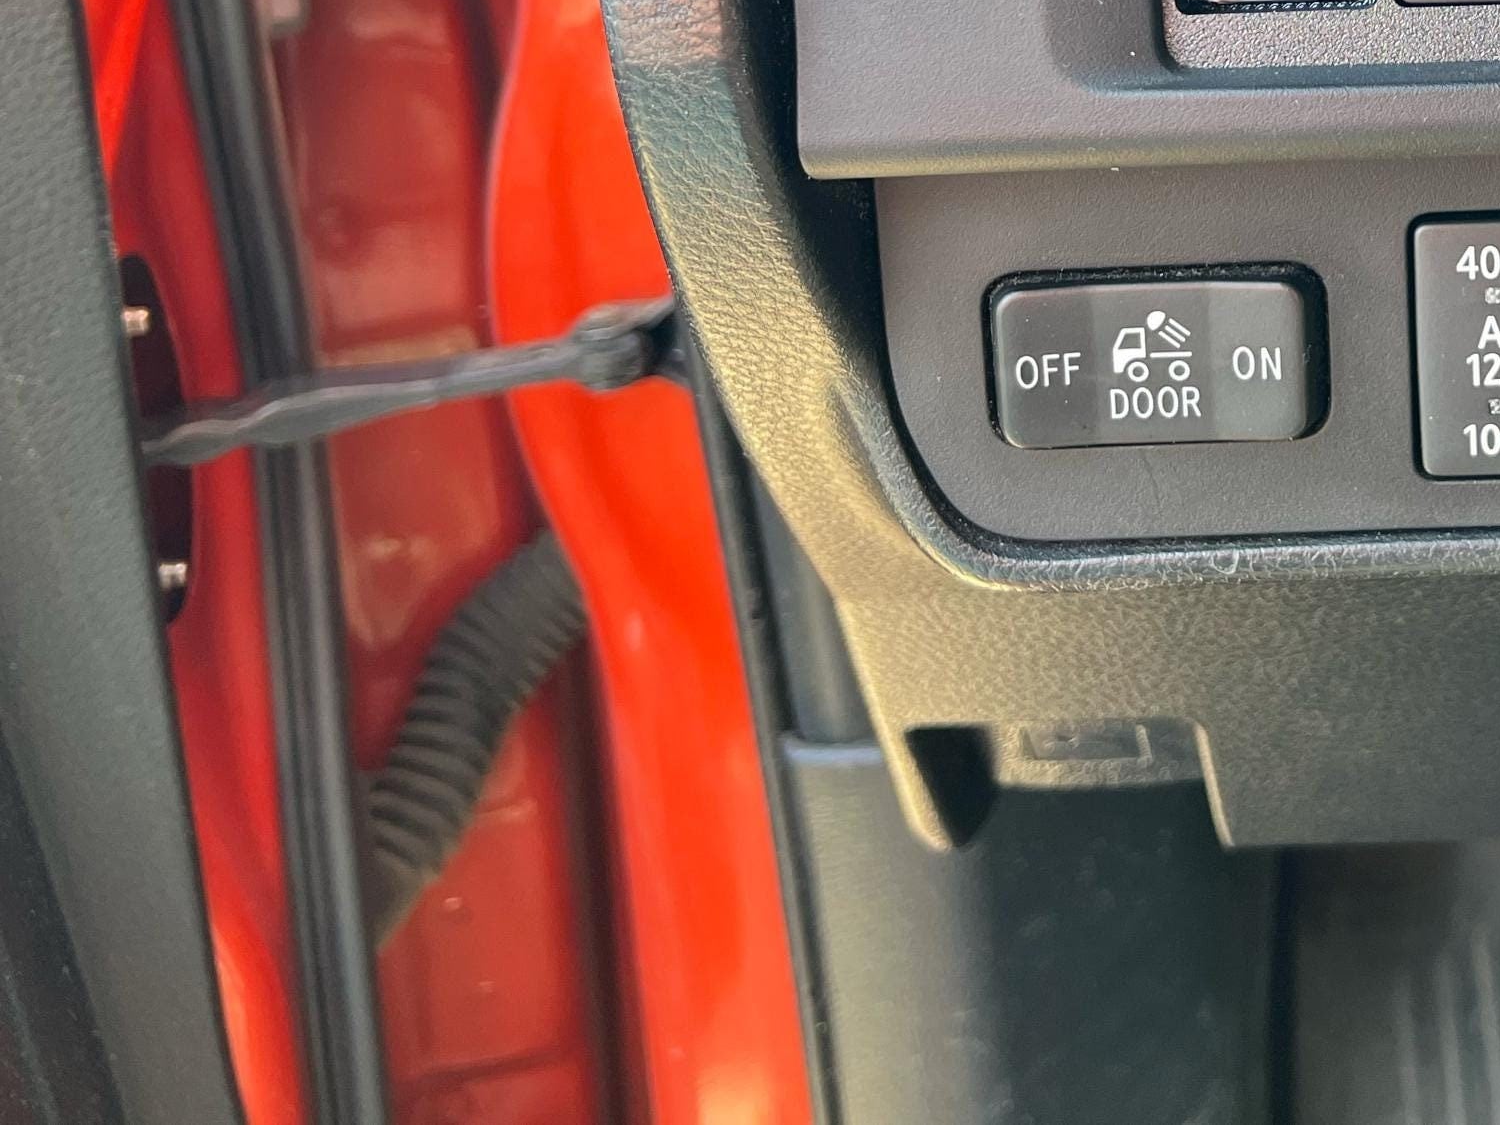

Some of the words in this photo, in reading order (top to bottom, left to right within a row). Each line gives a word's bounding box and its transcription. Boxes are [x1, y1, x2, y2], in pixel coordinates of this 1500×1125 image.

[1015, 352, 1082, 390] OFF
[1232, 346, 1283, 381] ON
[1109, 386, 1202, 419] DOOR
